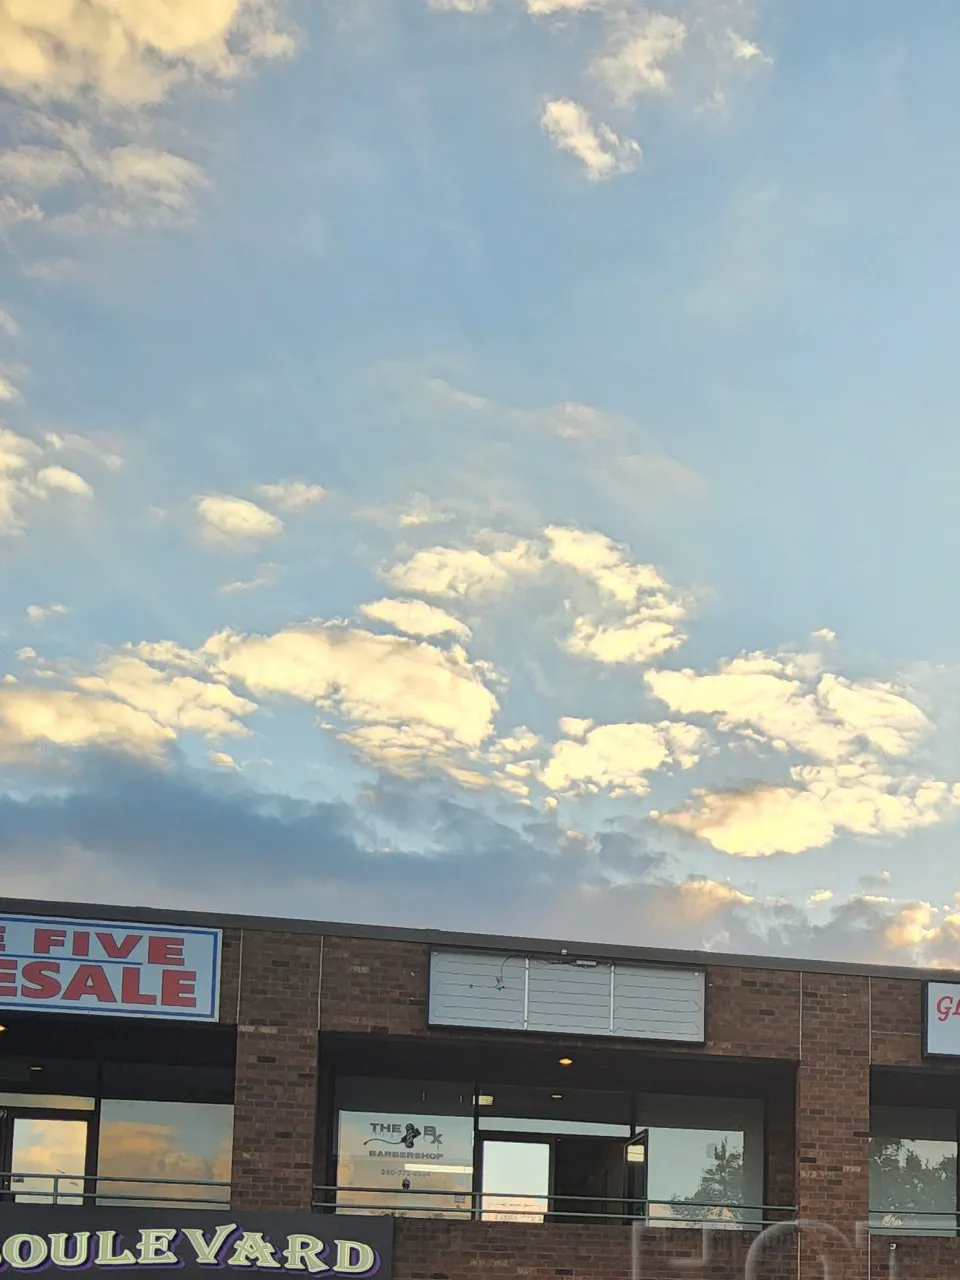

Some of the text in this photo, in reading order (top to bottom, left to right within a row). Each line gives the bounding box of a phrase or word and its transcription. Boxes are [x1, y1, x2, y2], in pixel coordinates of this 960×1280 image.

[33, 928, 185, 966] FIVE
[370, 1122, 402, 1135] THE
[368, 1150, 444, 1160] BARBERSHOP
[0, 1223, 377, 1275] OULEVARD
